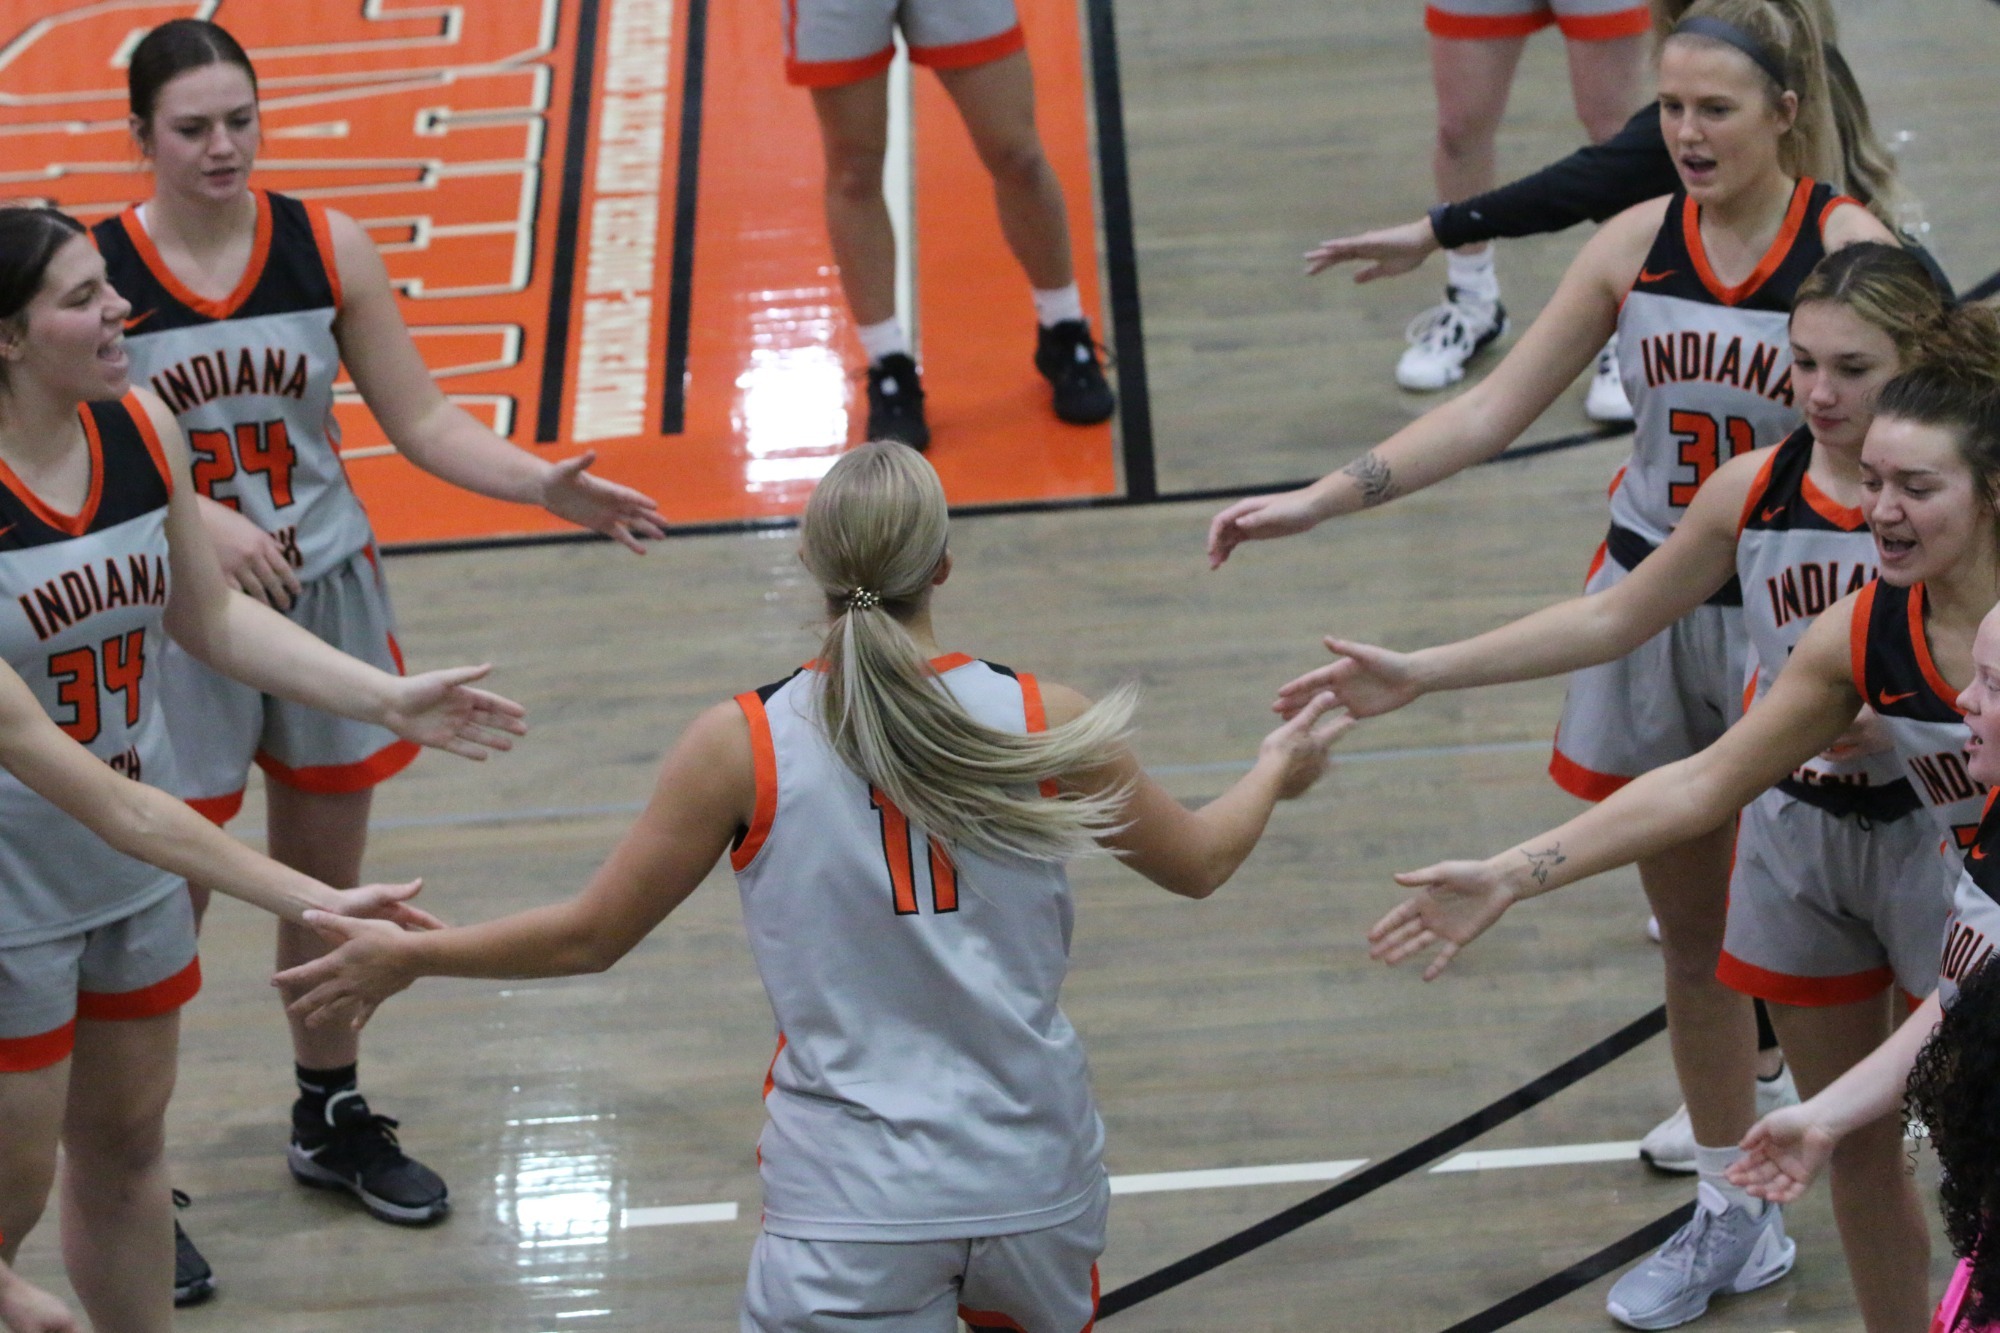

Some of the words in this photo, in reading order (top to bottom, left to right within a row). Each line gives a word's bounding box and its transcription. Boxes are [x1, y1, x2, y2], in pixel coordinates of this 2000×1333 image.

[151, 347, 309, 416] INDIANA
[1641, 331, 1795, 408] INDIANA
[188, 418, 297, 509] 24
[18, 553, 166, 642] INDIANA
[47, 627, 146, 744] 34
